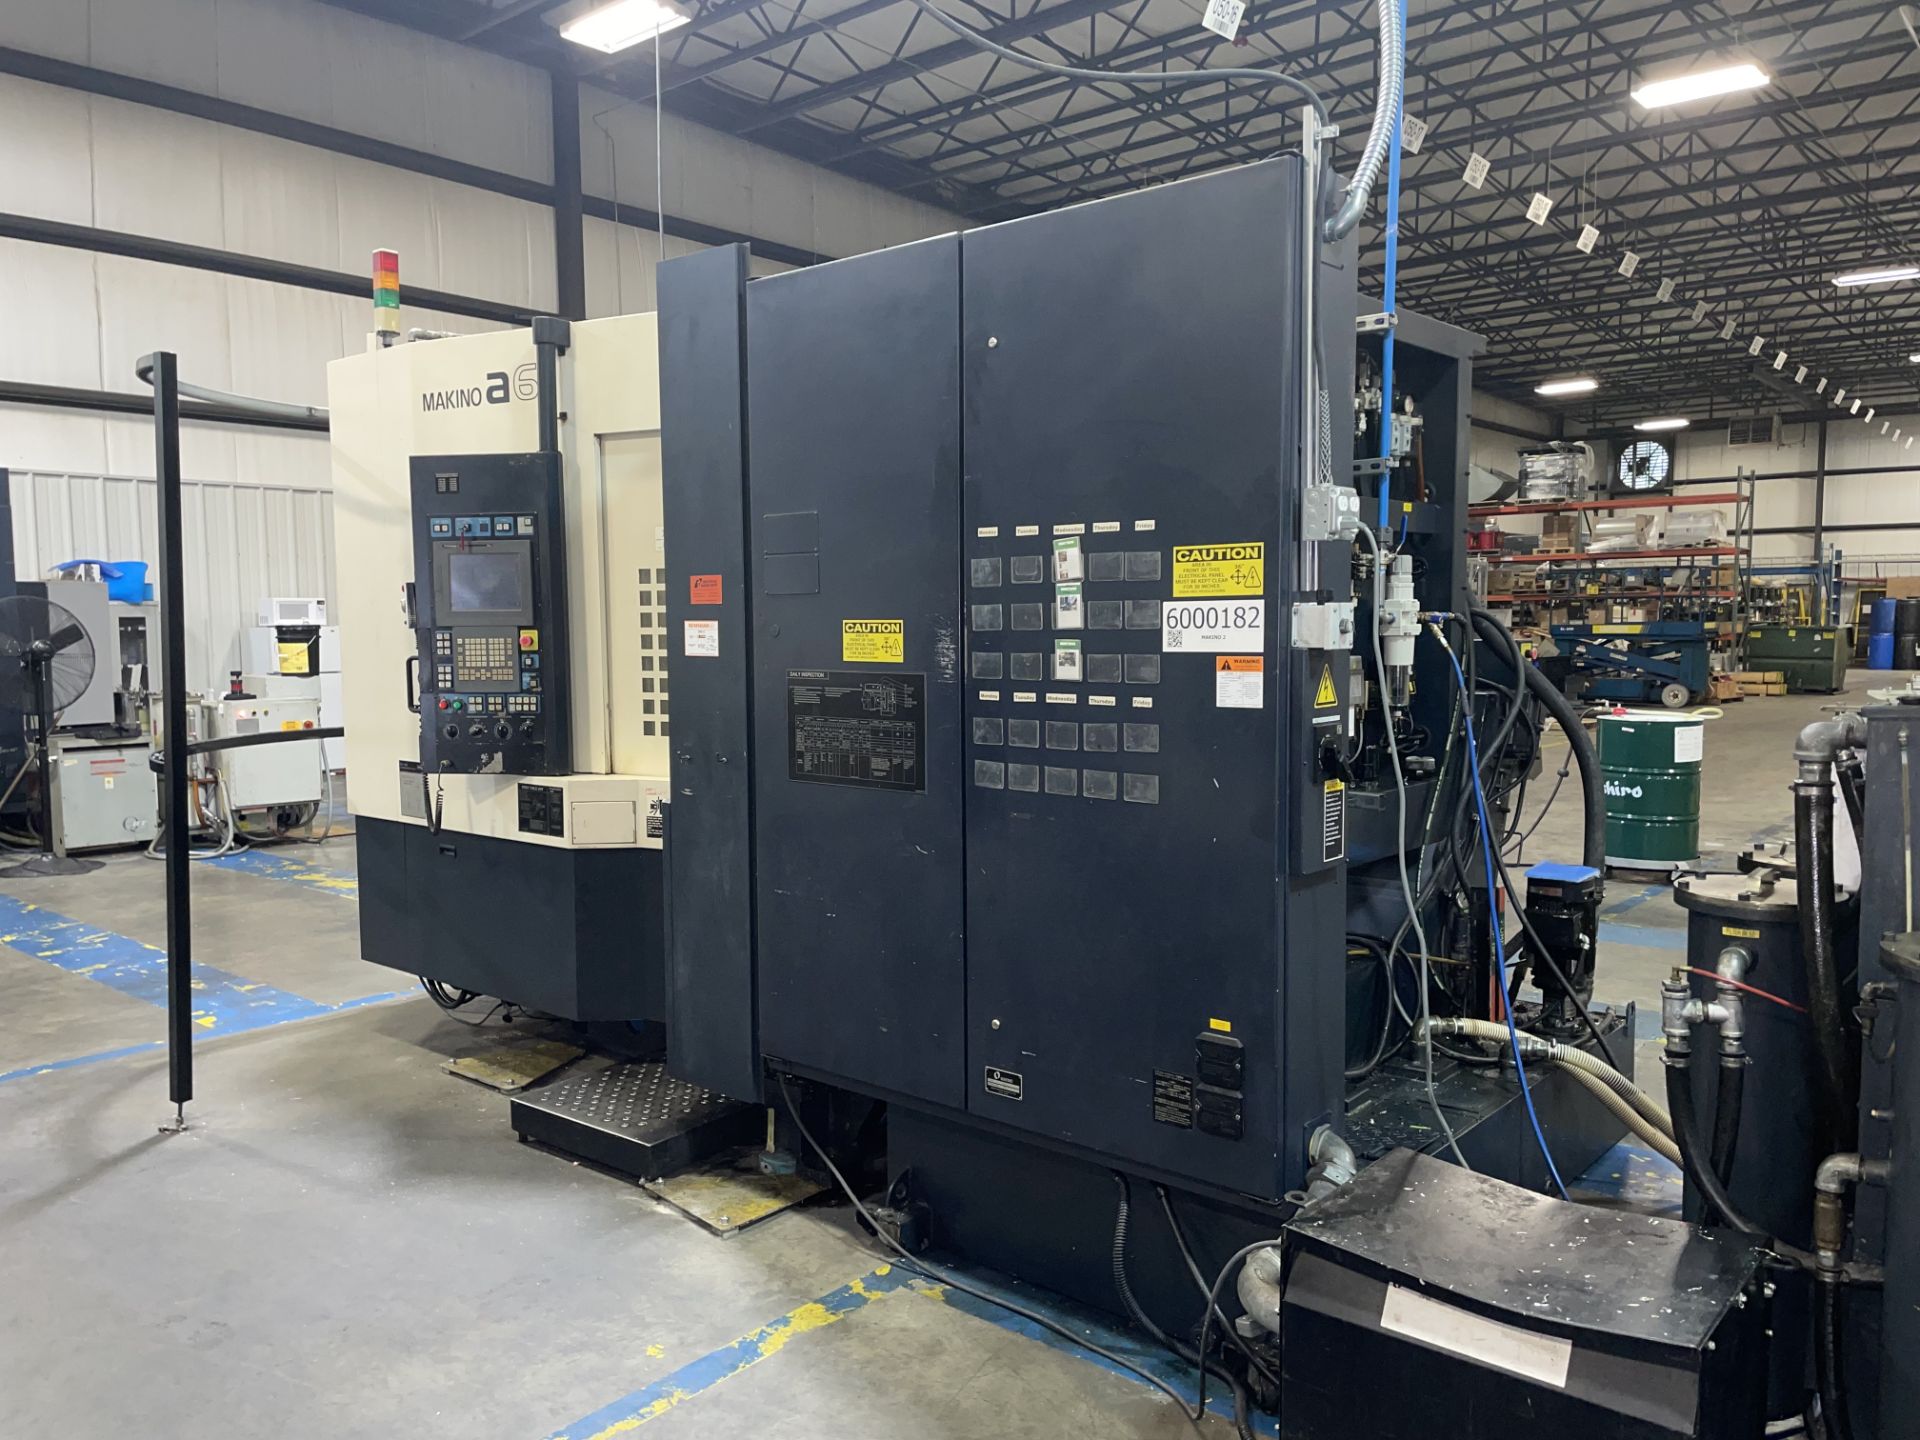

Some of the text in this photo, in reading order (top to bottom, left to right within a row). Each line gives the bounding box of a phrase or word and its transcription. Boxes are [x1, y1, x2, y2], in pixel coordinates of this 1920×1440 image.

[422, 387, 482, 412] MAKINO
[1094, 524, 1119, 532] Thursday
[1135, 522, 1153, 530] Friday
[1176, 547, 1260, 562] CAUTION
[1166, 606, 1261, 630] 6000182
[845, 623, 900, 633] CAUTION
